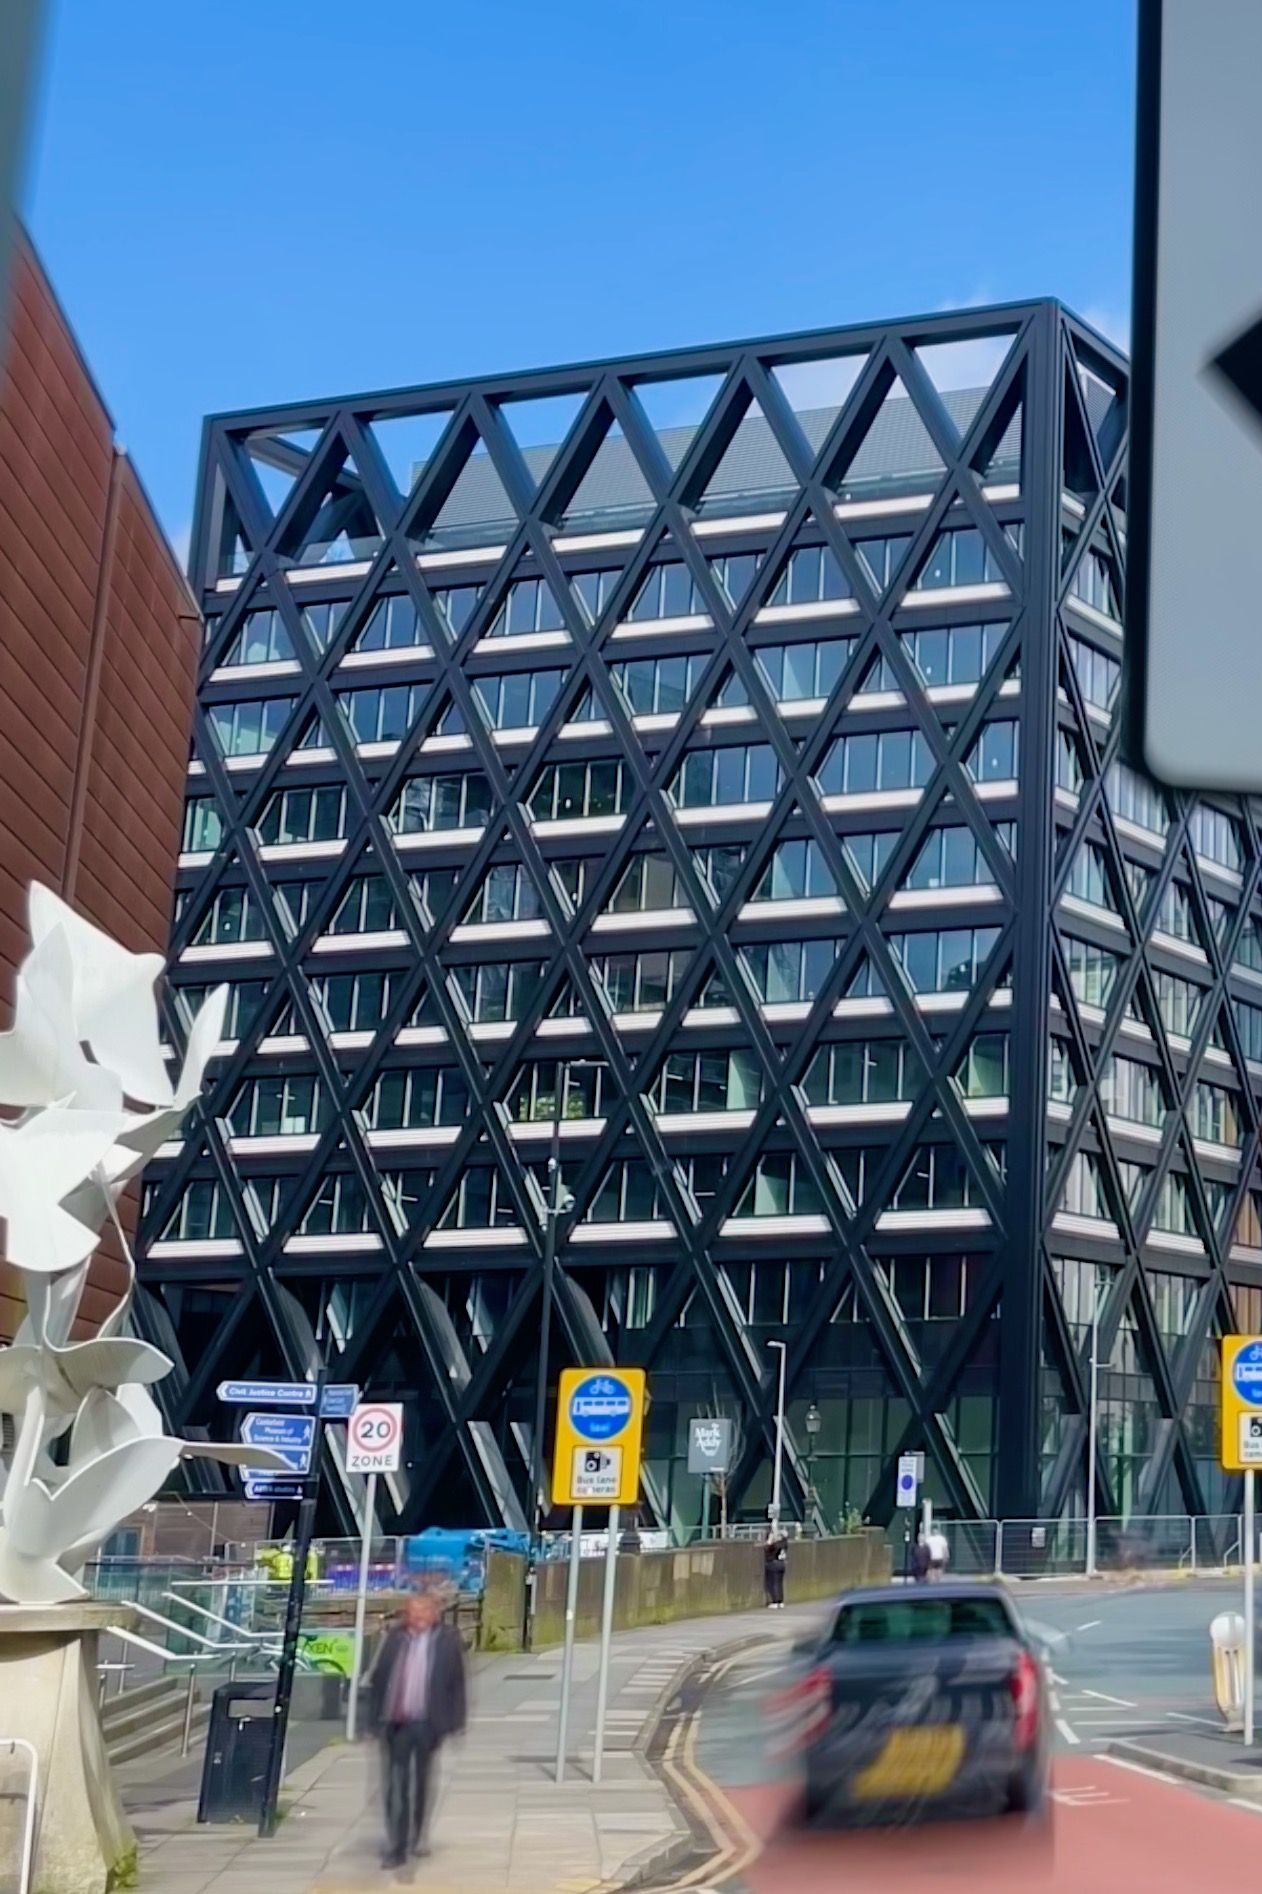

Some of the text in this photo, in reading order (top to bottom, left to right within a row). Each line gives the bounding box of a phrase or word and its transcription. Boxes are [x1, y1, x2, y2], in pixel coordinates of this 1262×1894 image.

[249, 1389, 275, 1397] Justice
[277, 1389, 303, 1398] Centre
[361, 1421, 390, 1438] 20
[695, 1428, 720, 1437] Mark
[696, 1437, 721, 1449] Addy
[1244, 1441, 1259, 1449] Bus
[351, 1455, 392, 1467] ZONE
[577, 1476, 616, 1484] Bus lane
